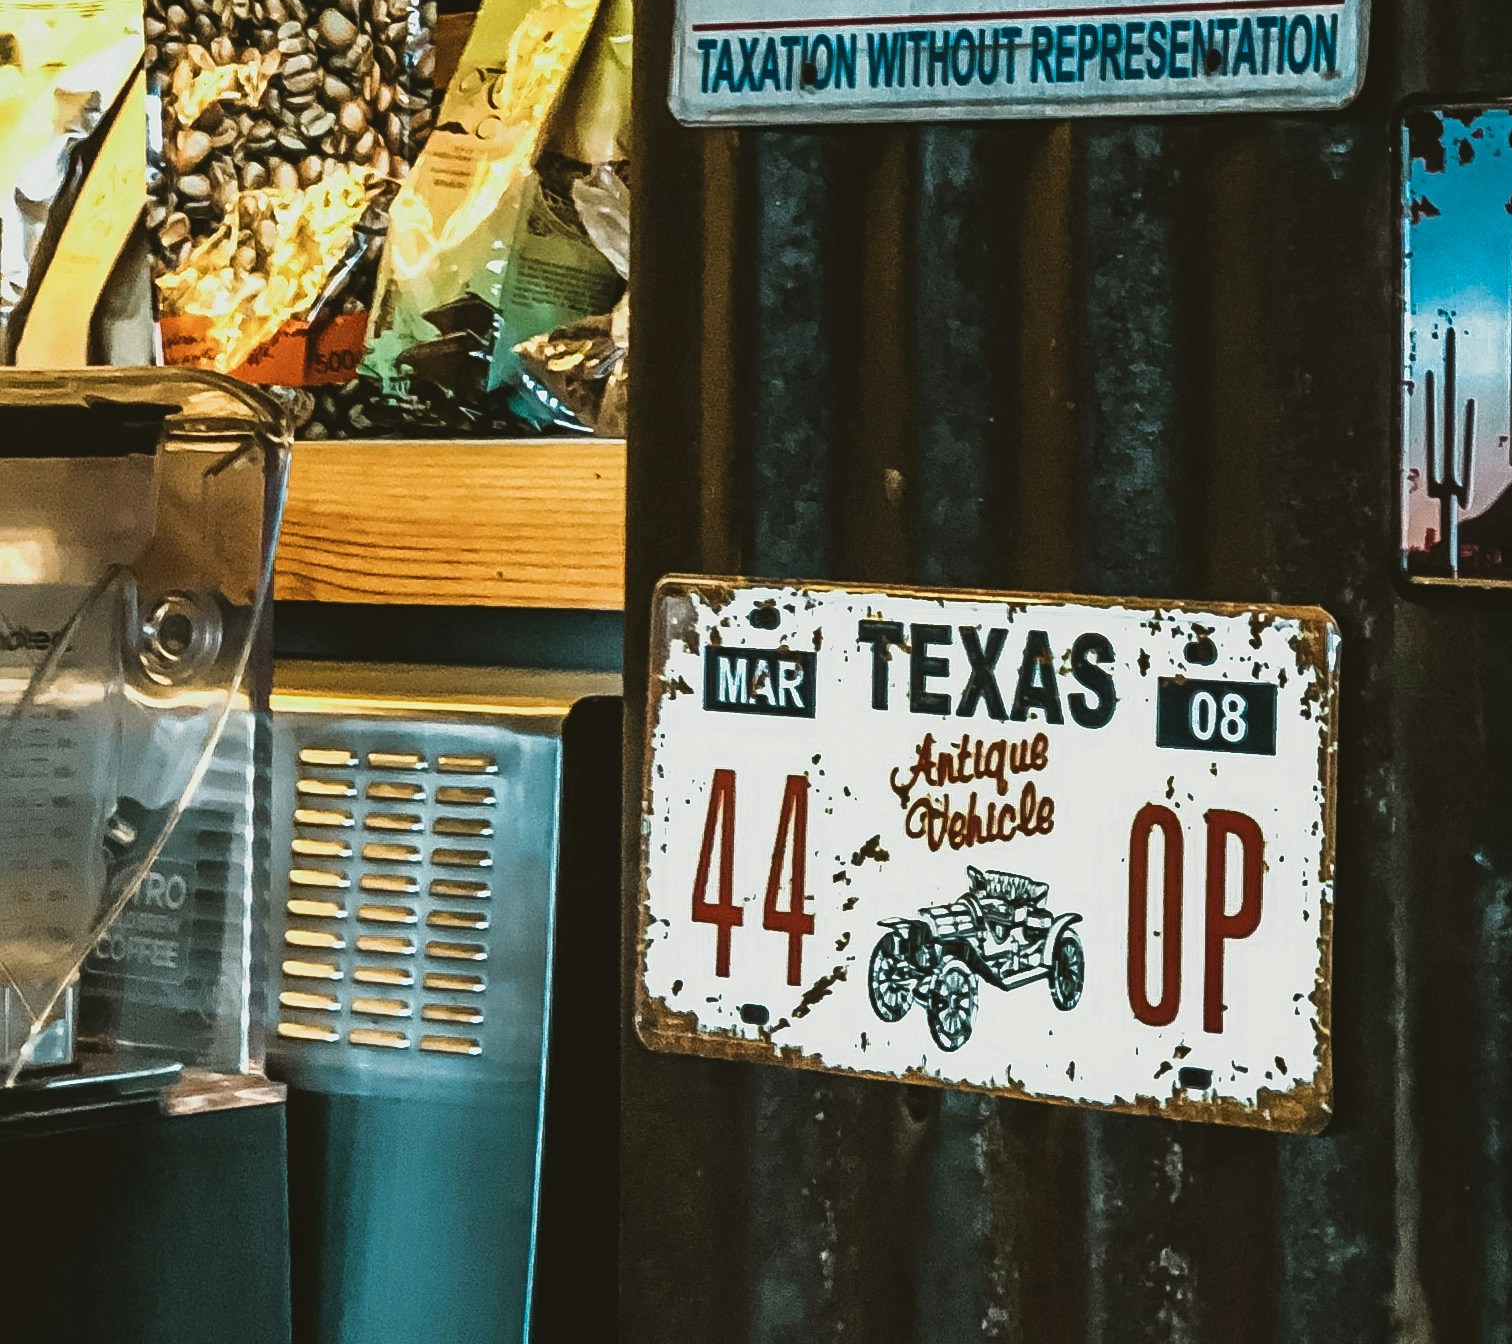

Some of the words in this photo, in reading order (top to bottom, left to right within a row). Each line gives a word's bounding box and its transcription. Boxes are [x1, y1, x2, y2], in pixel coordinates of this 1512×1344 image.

[699, 34, 858, 94] TAXATION
[866, 24, 1023, 89] WITHOUT
[1030, 13, 1338, 84] REPRESENTATION
[717, 655, 806, 710] MAR
[858, 618, 1118, 729] TEXAS
[1190, 691, 1249, 744] 08
[890, 731, 1050, 802] Antique
[905, 780, 1055, 853] Vehicle
[691, 768, 815, 987] 44
